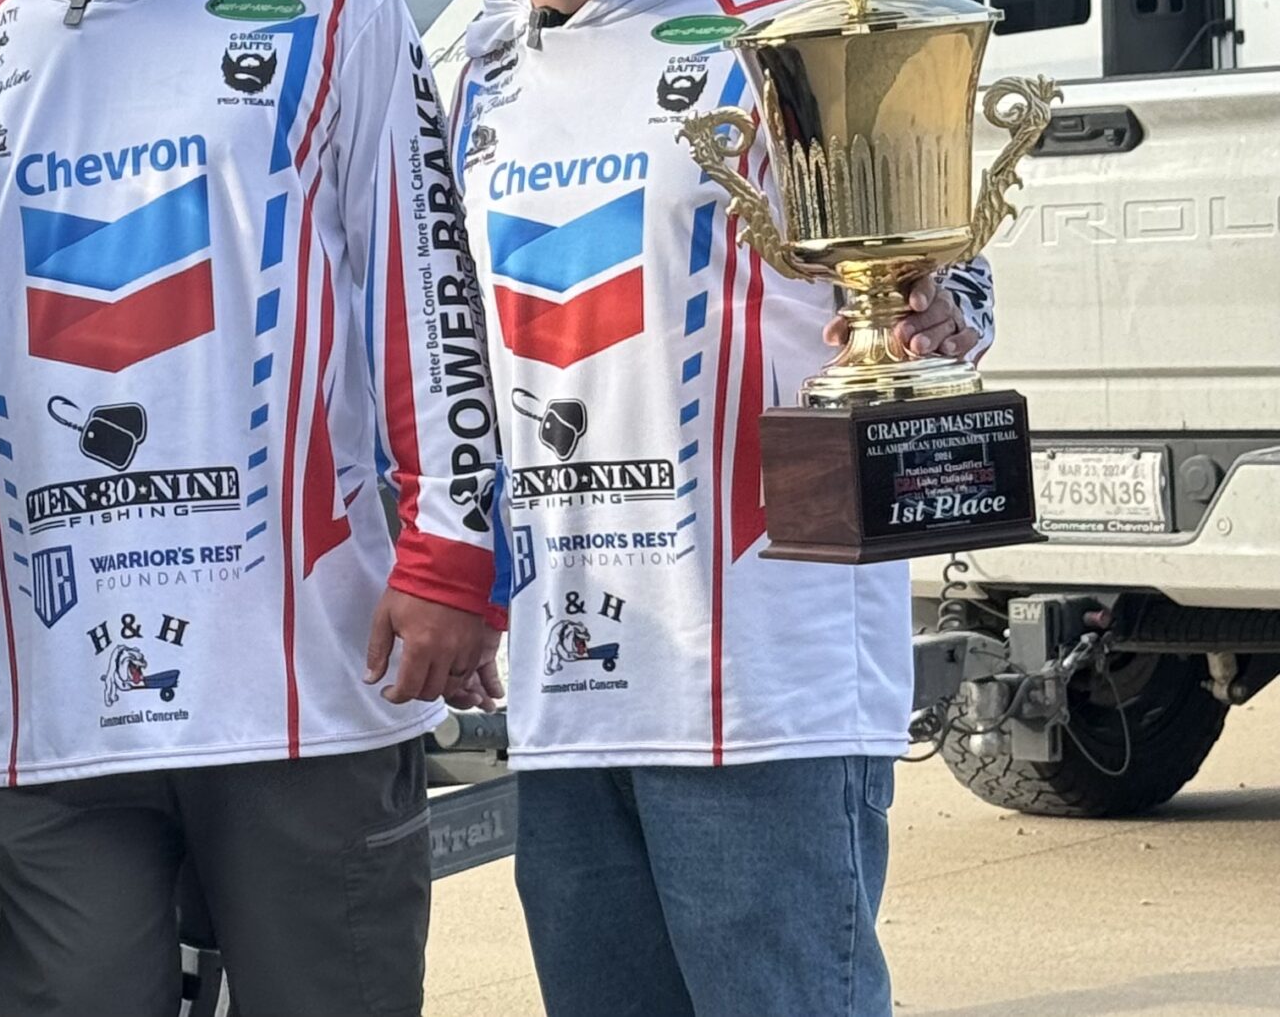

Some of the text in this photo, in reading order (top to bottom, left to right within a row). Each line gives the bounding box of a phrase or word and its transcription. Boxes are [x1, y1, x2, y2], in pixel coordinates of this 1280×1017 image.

[229, 42, 272, 51] BAITS
[666, 64, 706, 73] BAITS
[217, 97, 275, 107] PRO TEAM
[16, 134, 207, 196] Chevron
[489, 151, 649, 201] Chevron
[409, 135, 442, 394] Better Boat Control. More Fish Catches.
[867, 408, 1014, 441] CRAPPIE MASTERS
[866, 430, 1018, 457] ALL AMERICAN TOURNAMENT TRAIL
[512, 470, 547, 497] EN
[589, 462, 671, 489] NINE
[905, 460, 982, 476] National Qualifier
[28, 470, 239, 520] TEN 30 NINE
[528, 494, 622, 510] FIHING
[1040, 481, 1146, 505] 4763N36
[70, 505, 189, 528] FISHING
[888, 492, 1006, 525] 1st Place
[1041, 520, 1166, 532] Commerce Chevrolet
[632, 533, 678, 549] REST
[89, 544, 242, 575] WARRIOR'S REST
[96, 568, 241, 593] FOUNDATION
[565, 591, 587, 615] &
[598, 591, 626, 622] H
[86, 613, 190, 656] H & H
[589, 678, 629, 691] Concrete
[146, 709, 189, 722] Concrete
[431, 810, 504, 858] Trail
